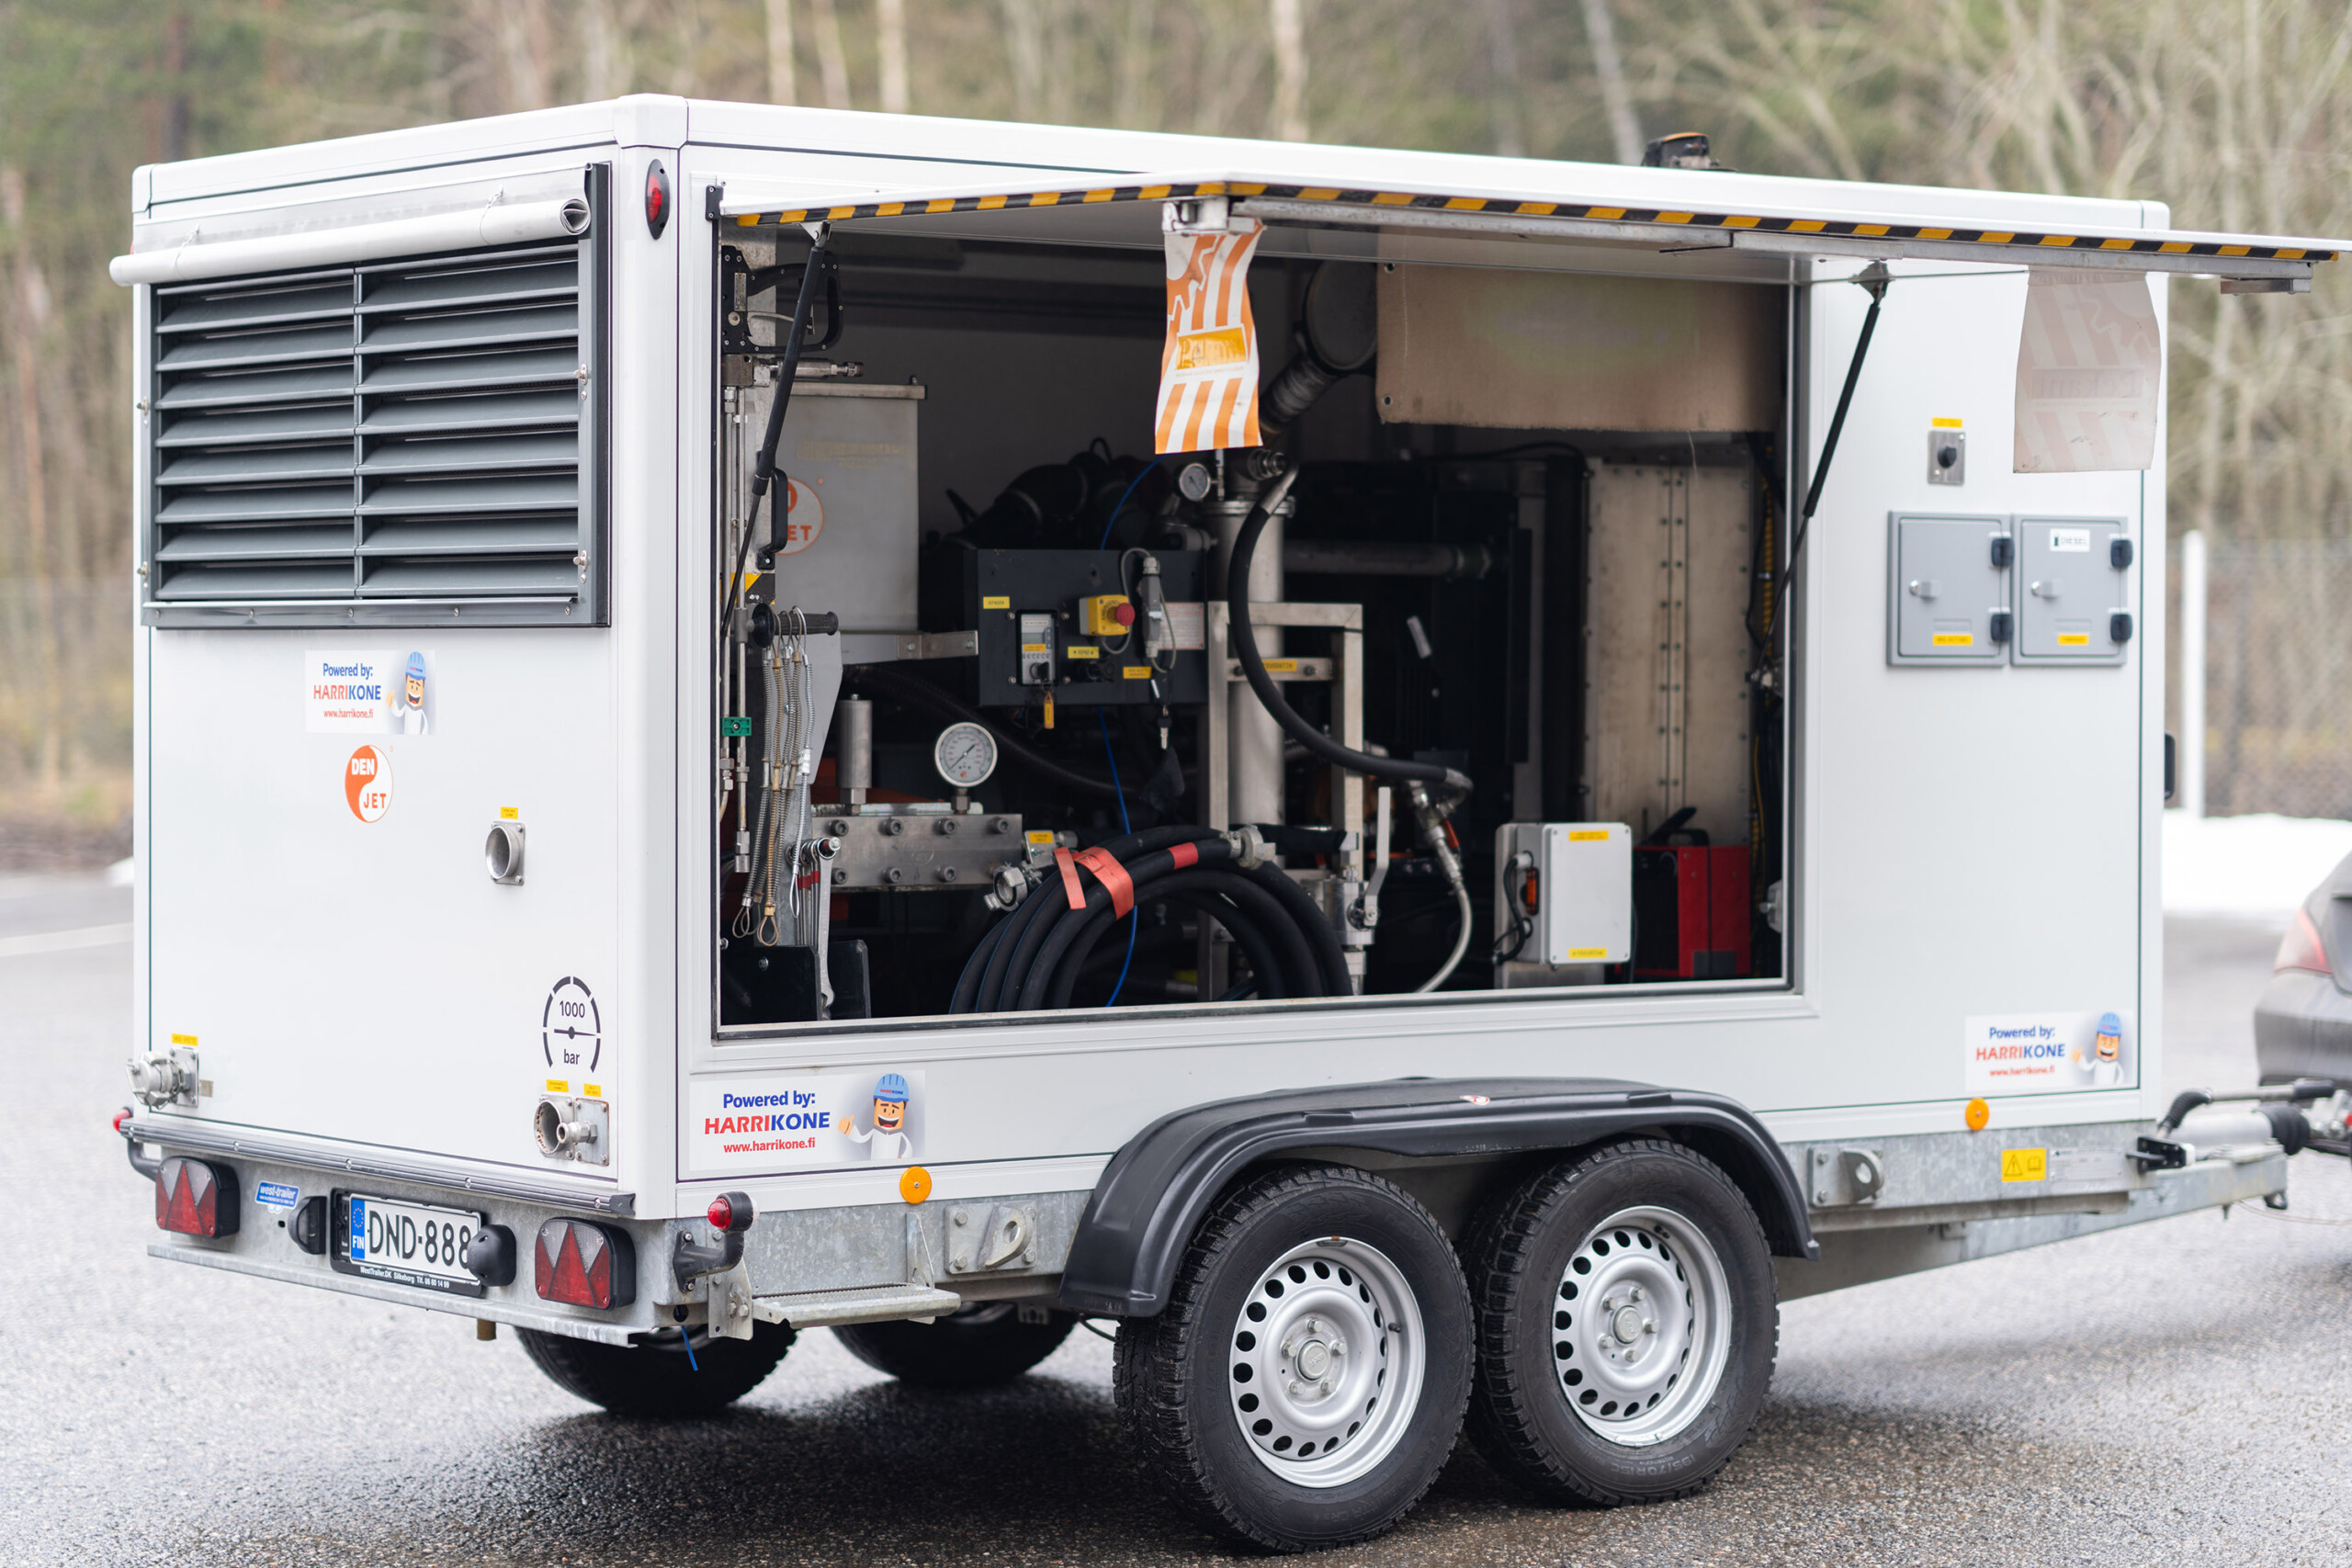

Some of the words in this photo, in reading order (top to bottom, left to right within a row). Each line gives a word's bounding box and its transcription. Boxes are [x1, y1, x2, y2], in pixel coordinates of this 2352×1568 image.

[787, 525, 812, 542] ET
[323, 662, 358, 677] Powered
[360, 662, 373, 681] by:
[313, 684, 381, 701] HARRIKONE
[323, 708, 374, 719] www.harrikone.fi
[351, 758, 375, 775] DEN
[363, 793, 387, 809] JET
[560, 1000, 585, 1019] 1000
[1989, 1025, 2036, 1040] Powered
[2039, 1024, 2056, 1041] by:
[563, 1048, 581, 1065] bar
[1975, 1043, 2065, 1061] HARRIKONE
[1989, 1065, 2055, 1077] www.harrikone.fi
[723, 1090, 788, 1109] Powered
[793, 1089, 816, 1109] by:
[704, 1111, 831, 1135] HARRIKONE
[723, 1137, 816, 1153] www.harrikone.fi
[352, 1235, 365, 1250] FIN
[369, 1210, 471, 1269] DND-888
[359, 1266, 392, 1279] WestTrailer.DK
[393, 1271, 415, 1284] Silkeborg
